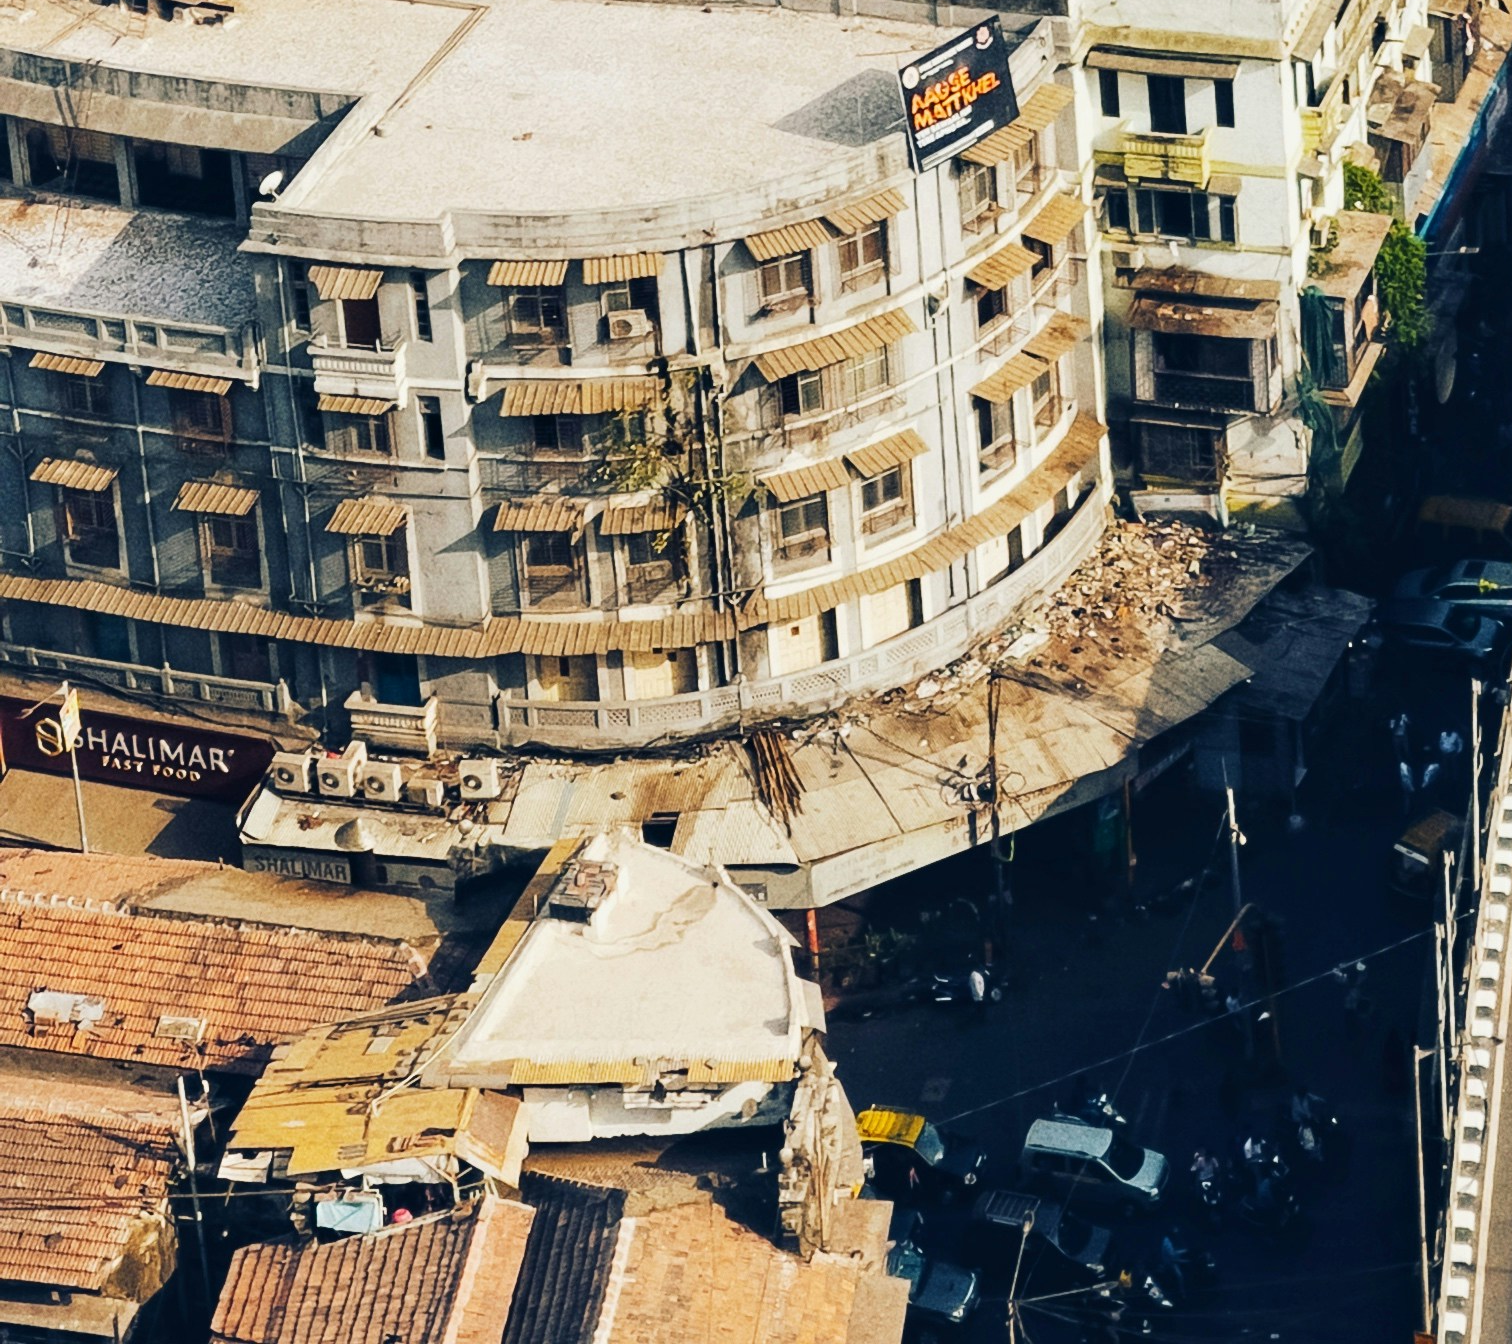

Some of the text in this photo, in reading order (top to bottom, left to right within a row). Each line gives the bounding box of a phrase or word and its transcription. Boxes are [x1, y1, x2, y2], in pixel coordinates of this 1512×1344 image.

[102, 754, 201, 783] FAST FOOD
[255, 856, 347, 882] SHALIMAR
